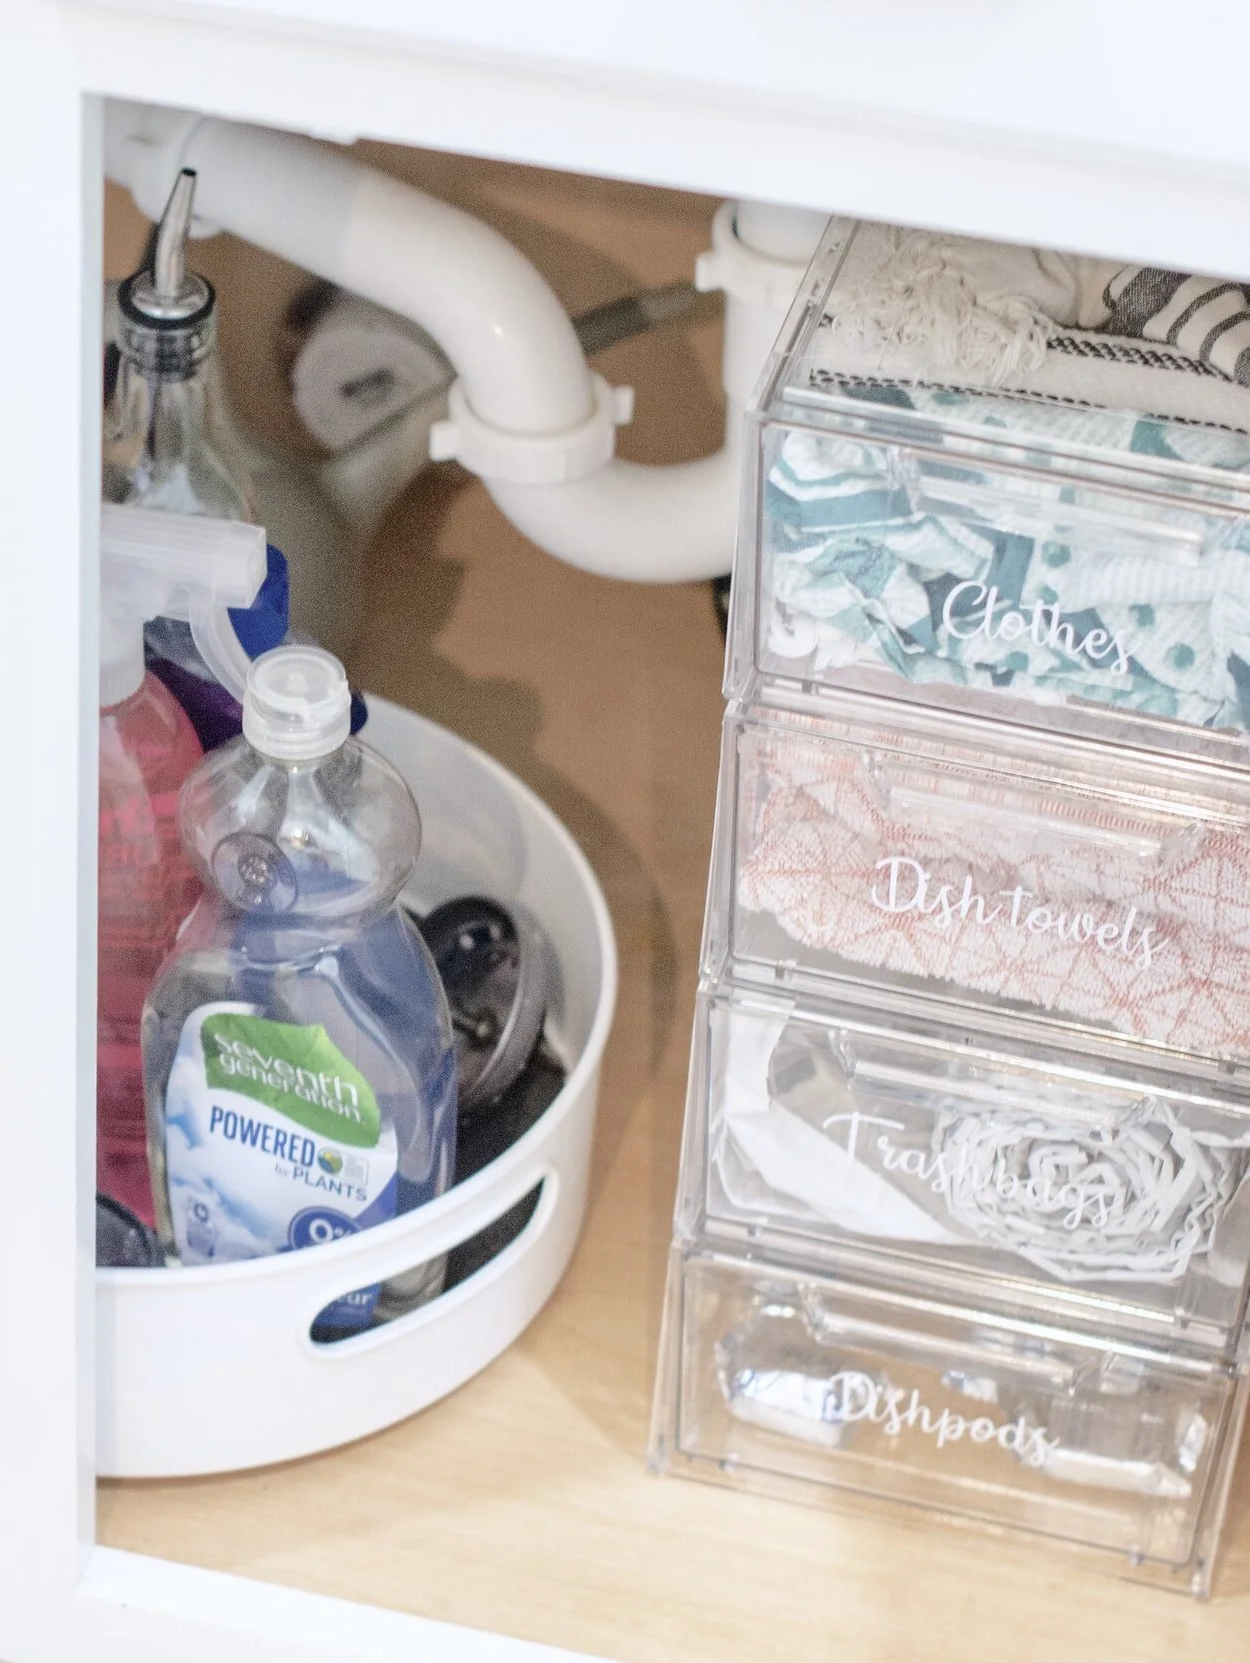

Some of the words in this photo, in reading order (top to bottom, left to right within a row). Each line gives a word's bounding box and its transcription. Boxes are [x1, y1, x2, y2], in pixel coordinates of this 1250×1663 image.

[941, 577, 1141, 676] Clothes
[871, 855, 1001, 928] Dish
[1001, 885, 1170, 969] towels
[213, 1031, 358, 1108] seventh
[218, 1050, 362, 1125] generation
[208, 1104, 317, 1169] POWERED
[821, 1111, 990, 1193] Trash
[994, 1156, 1117, 1229] bags
[291, 1167, 368, 1203] PLANTS
[828, 1370, 1062, 1468] Dishpods
